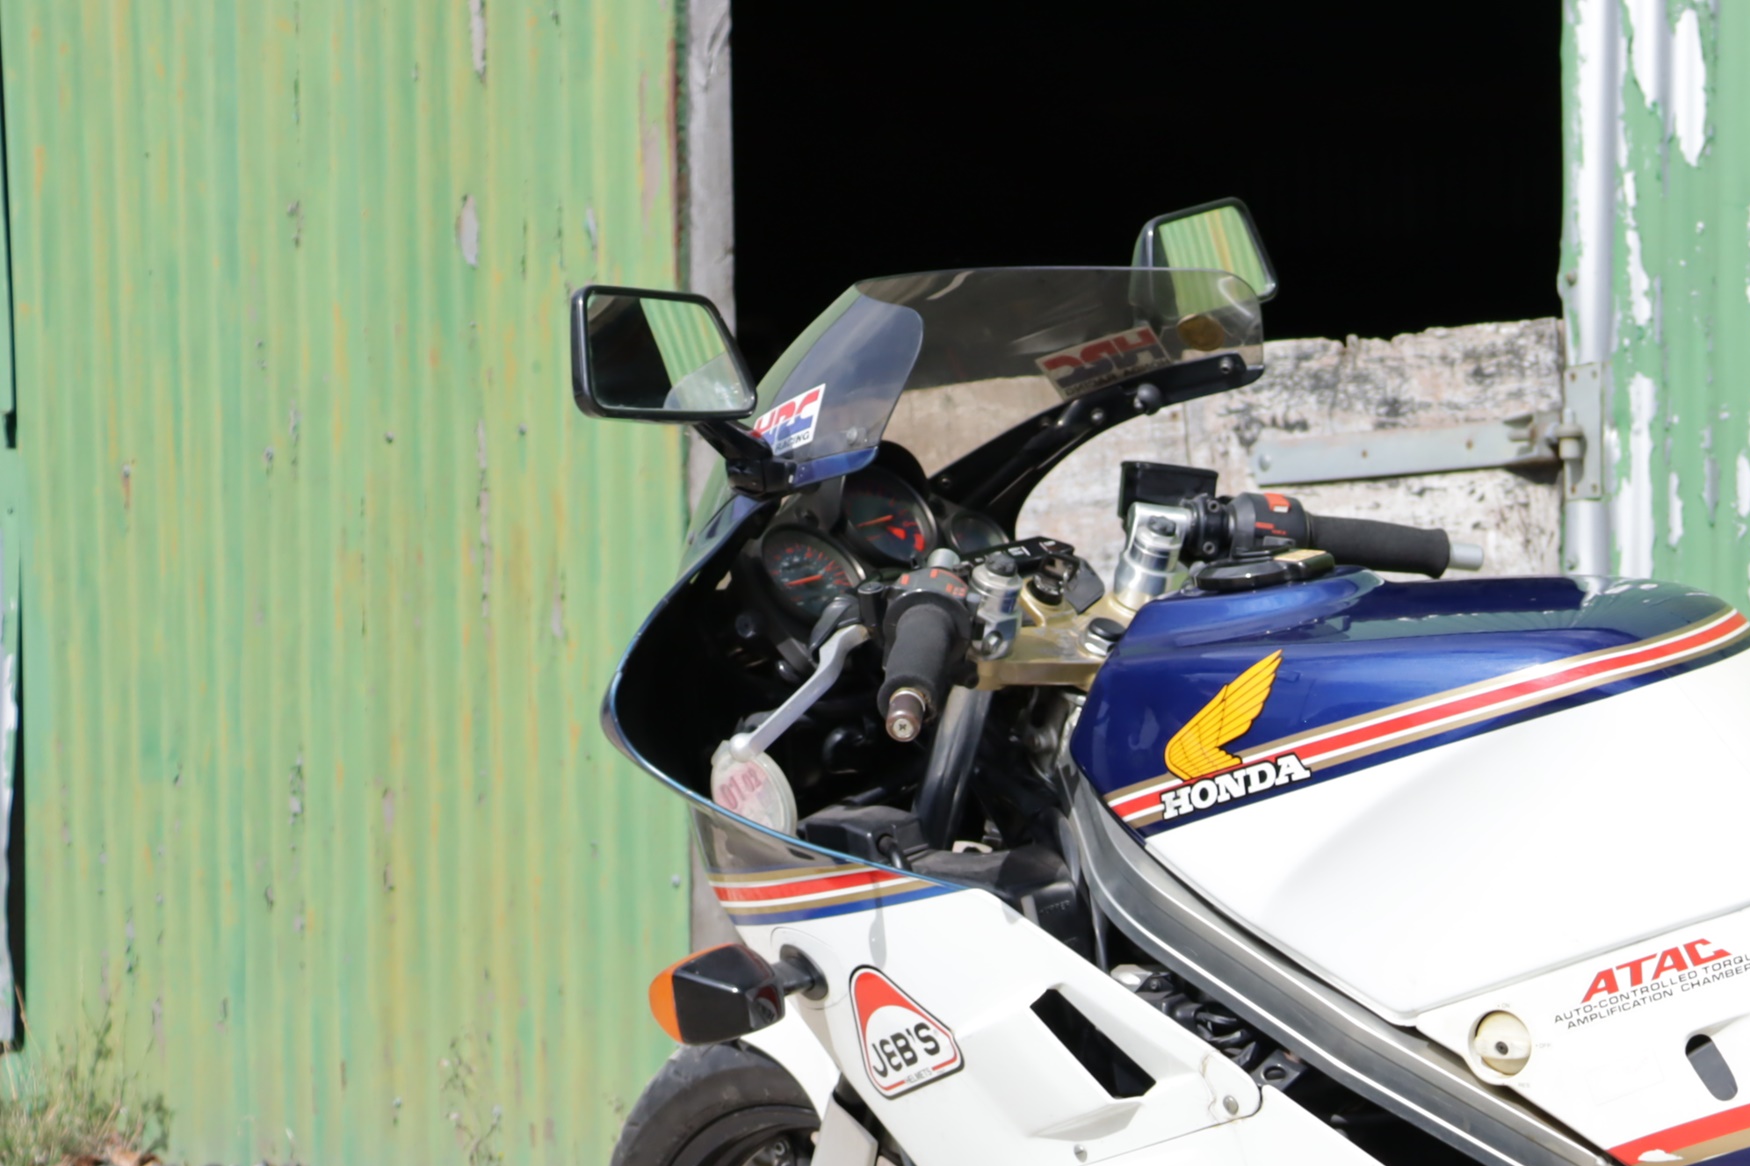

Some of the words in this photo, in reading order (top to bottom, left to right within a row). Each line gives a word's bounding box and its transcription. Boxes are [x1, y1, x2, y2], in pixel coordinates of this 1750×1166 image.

[1159, 752, 1311, 820] HONDA
[1554, 969, 1698, 1024] AUTO-CONTROLLED
[1580, 937, 1733, 1005] ATAC
[1566, 989, 1674, 1030] AMPLIFICATION
